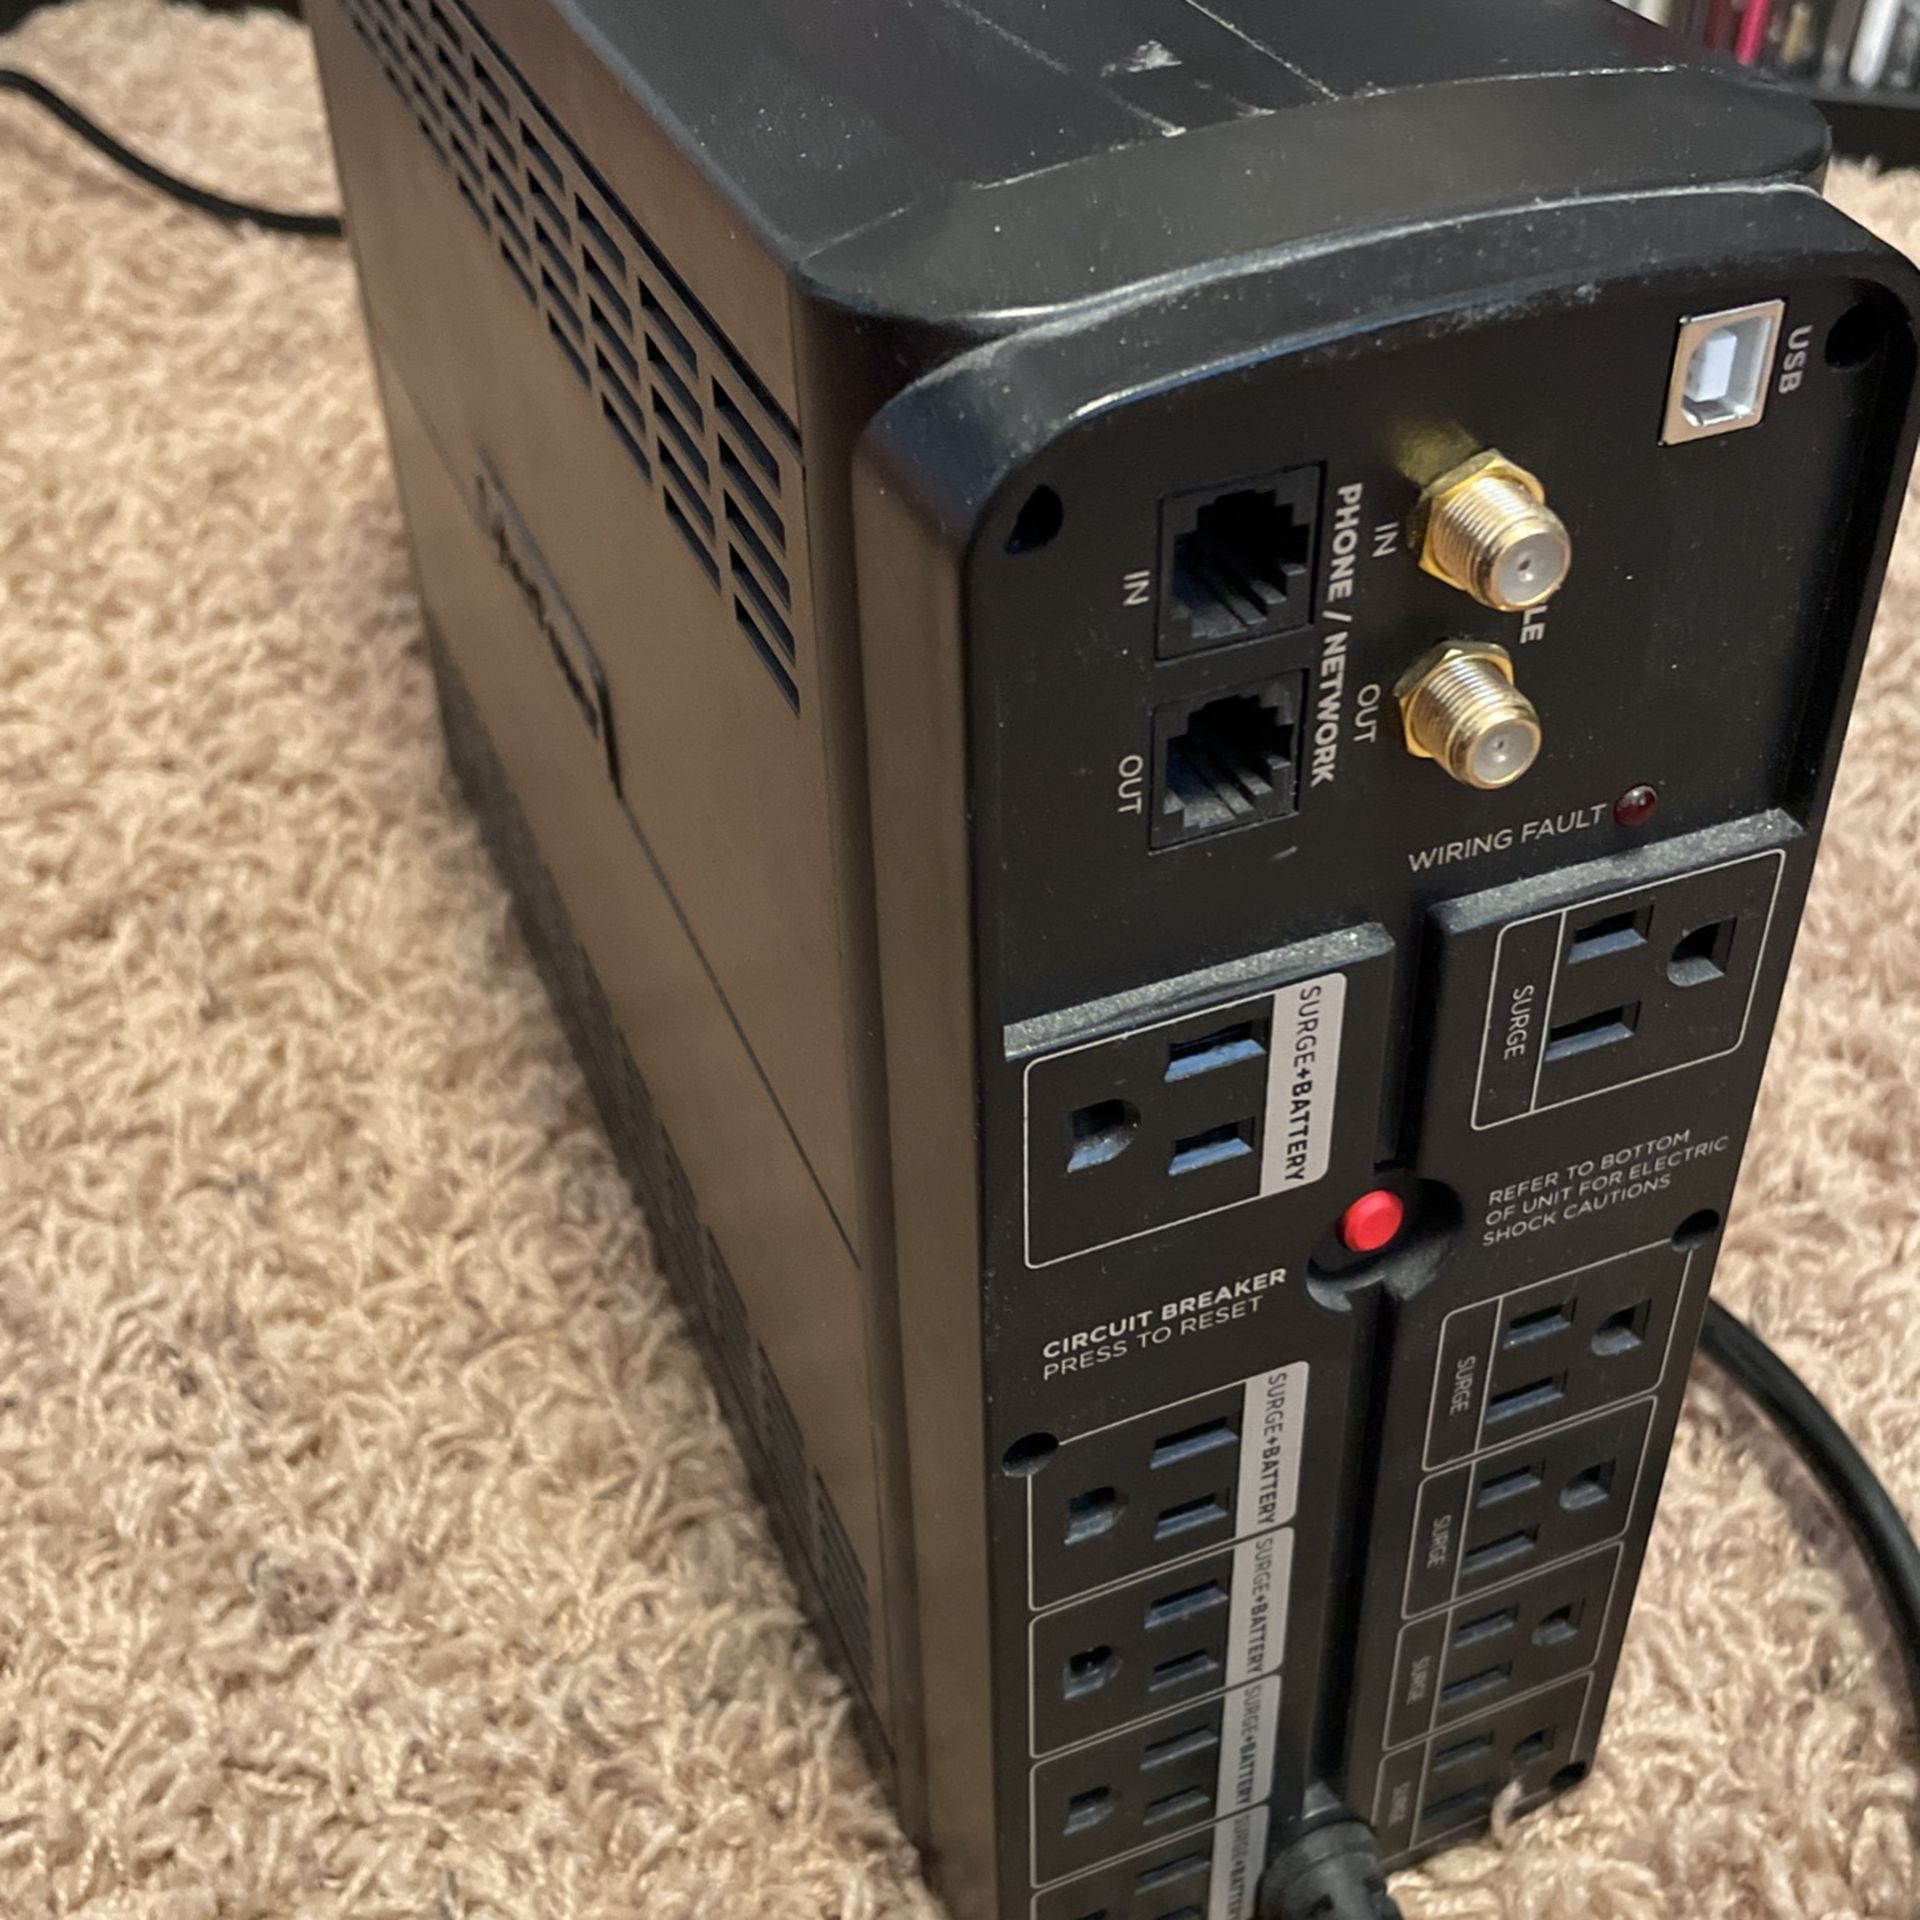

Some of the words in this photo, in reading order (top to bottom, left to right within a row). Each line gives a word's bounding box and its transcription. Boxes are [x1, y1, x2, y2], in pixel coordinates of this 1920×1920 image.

[1779, 324, 1813, 394] USB
[1327, 483, 1363, 602] PHONE
[1372, 522, 1399, 557] IN
[1122, 570, 1151, 606] IN
[1322, 610, 1353, 623] /
[1310, 632, 1348, 788] NETWORK
[1353, 683, 1382, 743] OUT
[1117, 754, 1144, 814] OUT
[1408, 829, 1514, 873] WIRING
[1520, 803, 1607, 844] FAULT
[1503, 984, 1535, 1060] SURGE
[1284, 985, 1322, 1181] SURGE+BATTERY
[1485, 1204, 1516, 1226] OF
[1522, 1186, 1573, 1215] UNIT
[1578, 1170, 1623, 1197] FOR
[1628, 1136, 1729, 1180] ELECTRIC
[1488, 1171, 1559, 1206] REFER
[1566, 1161, 1594, 1180] TO
[1600, 1128, 1690, 1171] BOTTOM
[1482, 1212, 1556, 1247] SHOCK
[1563, 1173, 1671, 1220] CAUTIONS
[1043, 1310, 1153, 1359] CIRCUIT
[1161, 1267, 1287, 1321] BREAKER
[1043, 1340, 1128, 1381] PRESS
[1136, 1326, 1172, 1348] TO
[1180, 1295, 1263, 1335] RESET
[1449, 1355, 1476, 1416] SURGE
[1258, 1372, 1287, 1526] SURGE+BATTERY
[1427, 1514, 1451, 1569] SURGE
[1247, 1537, 1274, 1675] SURGE+BATTERY
